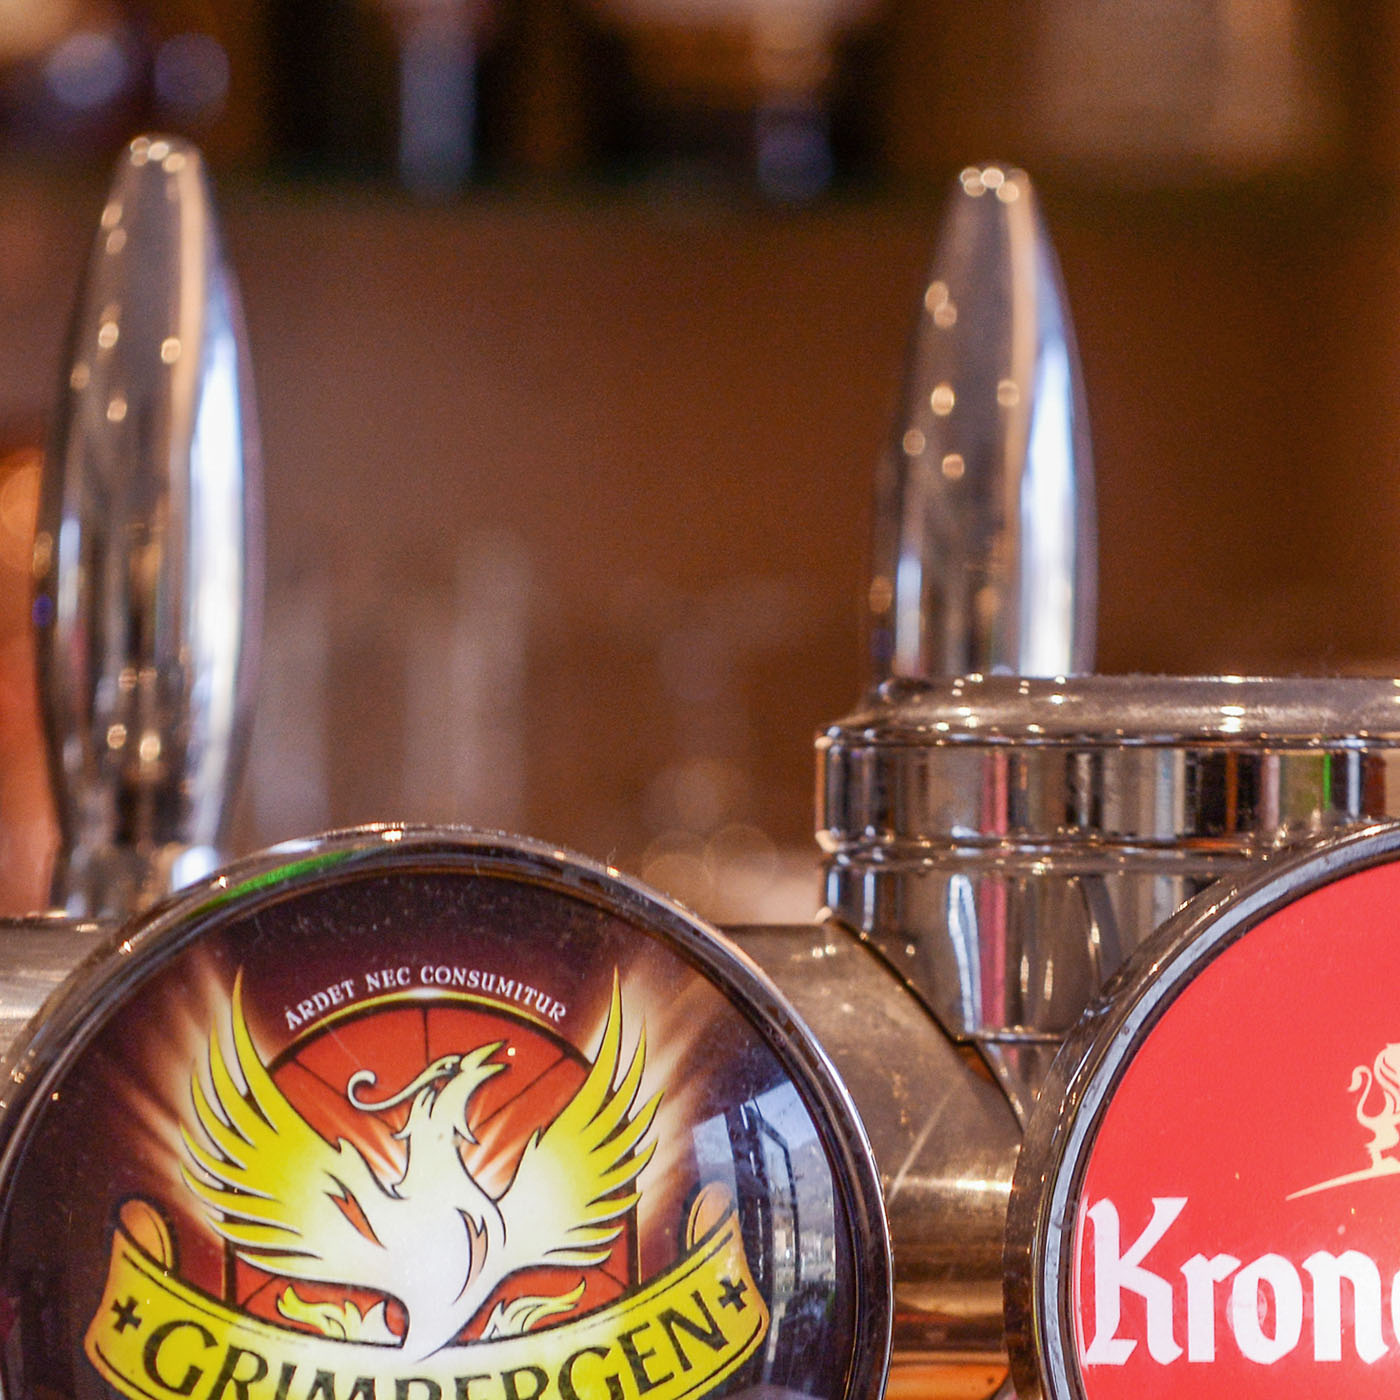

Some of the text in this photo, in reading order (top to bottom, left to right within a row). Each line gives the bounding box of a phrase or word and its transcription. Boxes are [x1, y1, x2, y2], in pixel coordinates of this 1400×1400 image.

[285, 965, 568, 1031] ARDET NEC CONSUMITUR
